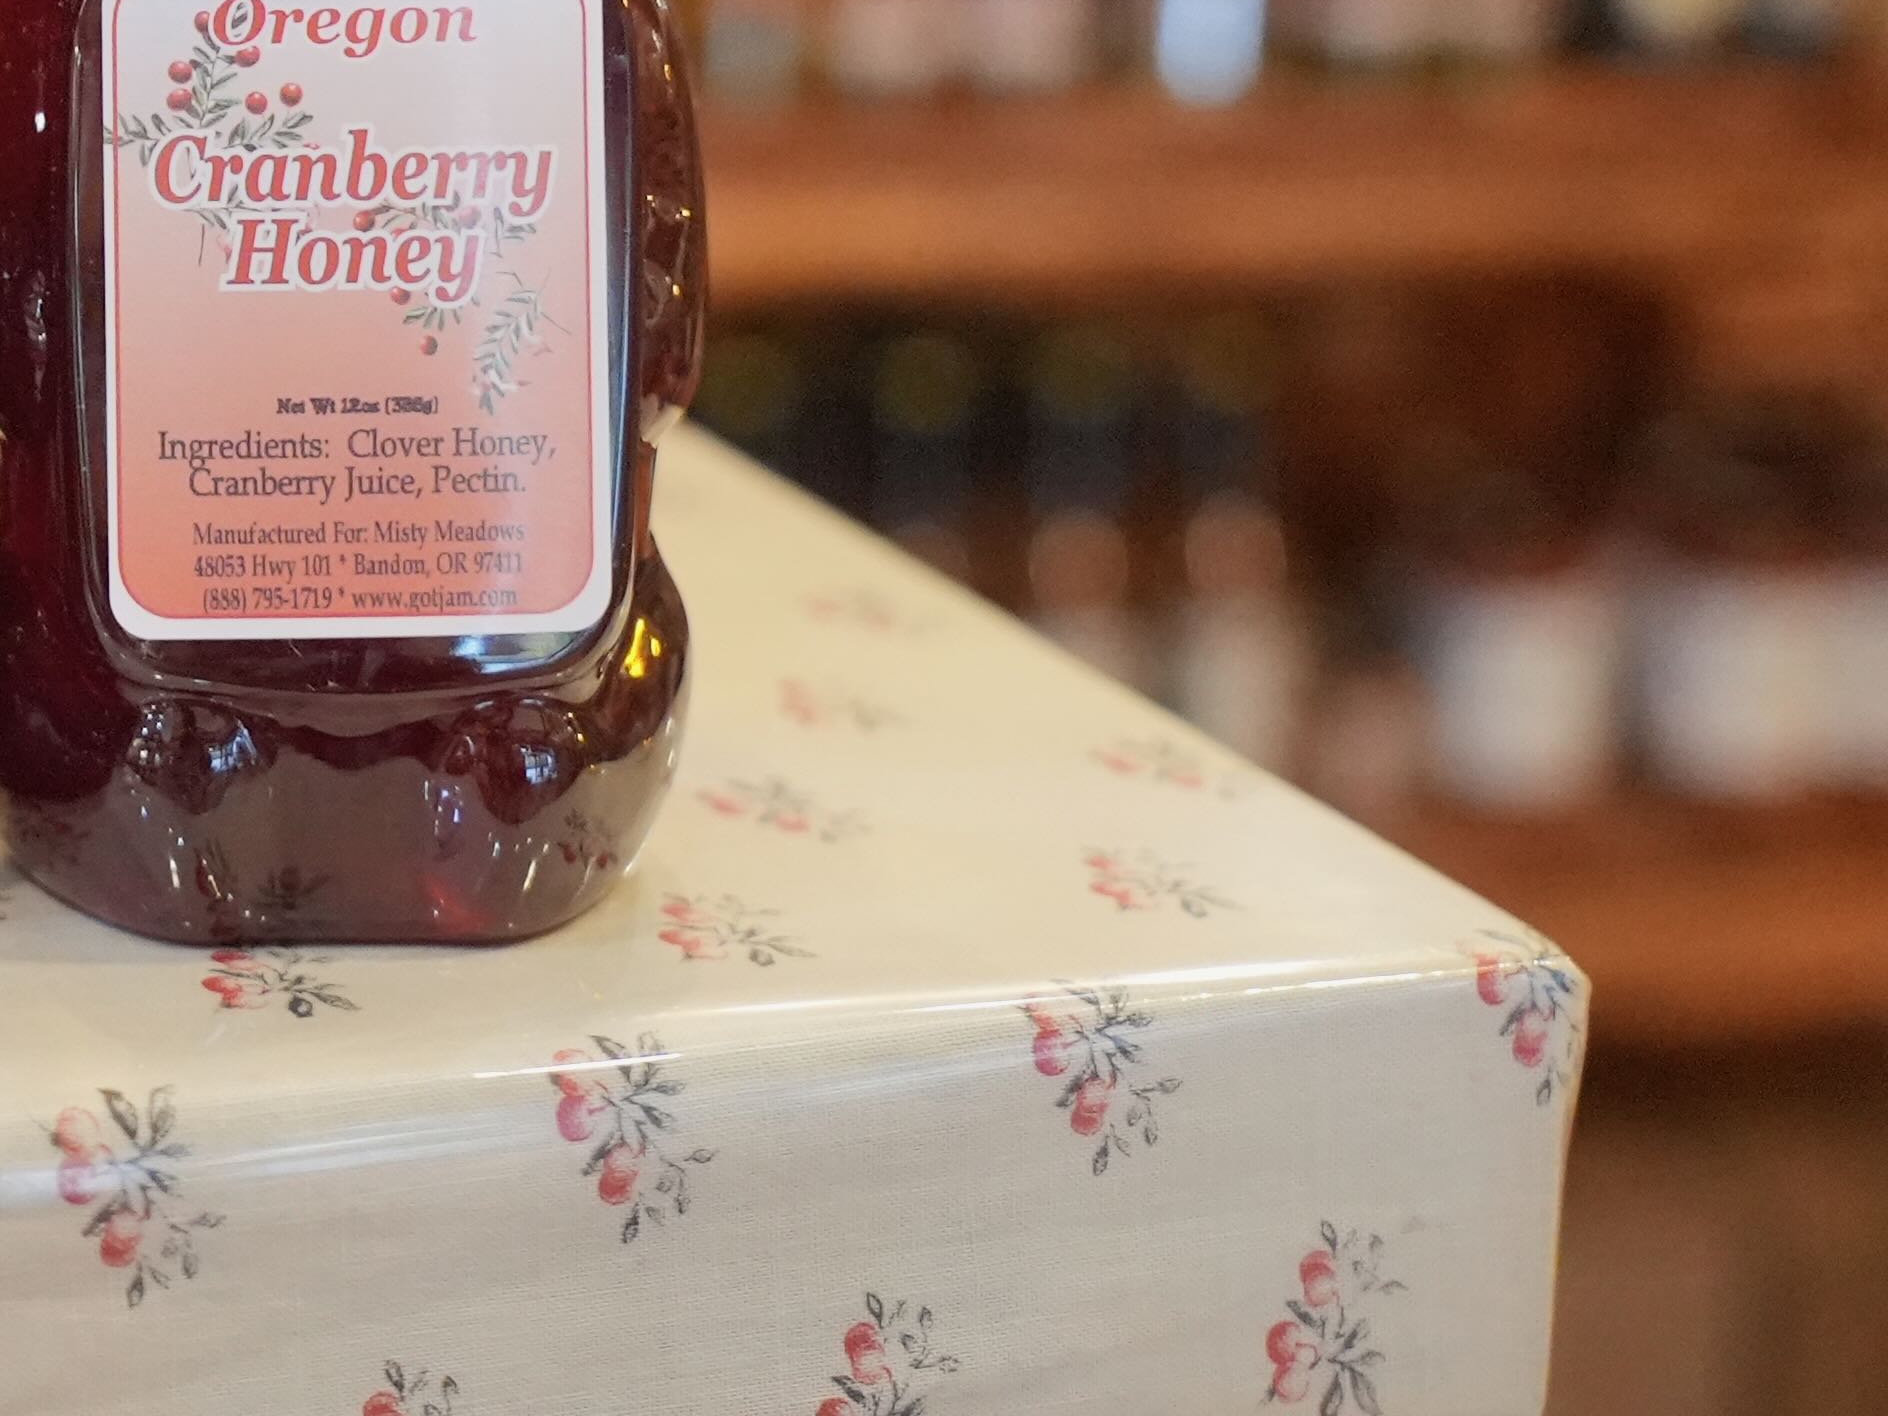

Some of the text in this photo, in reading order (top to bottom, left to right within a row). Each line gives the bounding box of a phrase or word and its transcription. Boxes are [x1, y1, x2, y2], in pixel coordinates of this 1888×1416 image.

[154, 129, 552, 217] Cranberry
[227, 218, 480, 302] Honey
[309, 397, 336, 415] Wt
[158, 428, 557, 469] Ingredients: Clover Honey,
[188, 465, 527, 504] Cranberry Juice, Pectin.
[192, 520, 526, 552] Manufactured For: Misty Meadows
[193, 551, 522, 585] 48053 Hwy 101 Bandon, OR 97411
[203, 585, 518, 614] (888) 795-1719 www.gotjam.com
